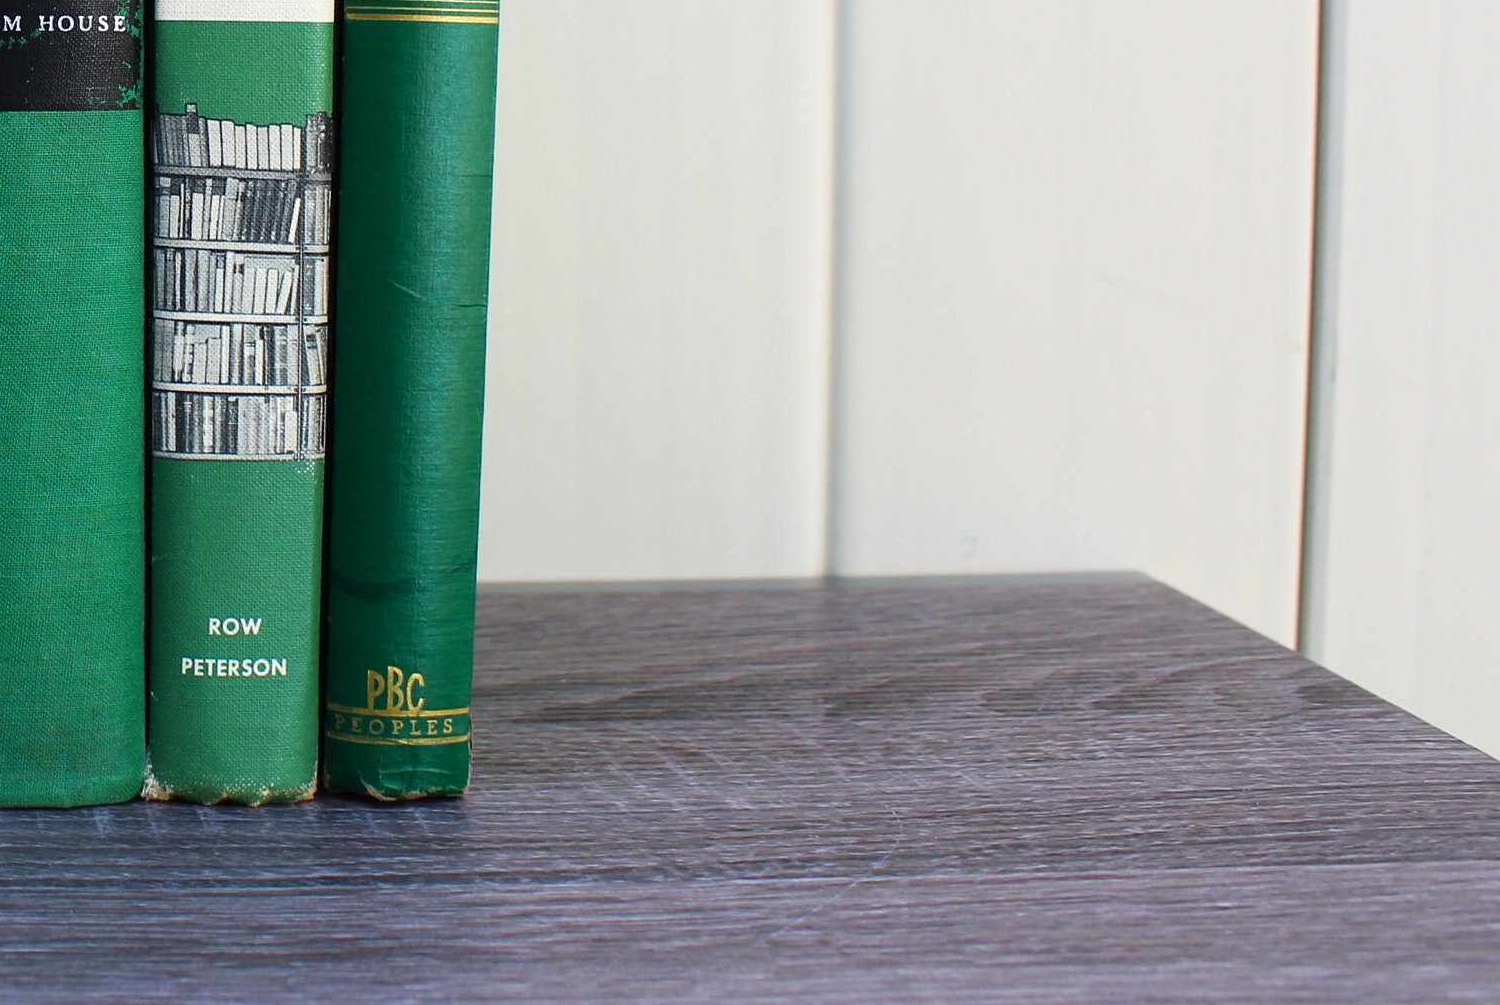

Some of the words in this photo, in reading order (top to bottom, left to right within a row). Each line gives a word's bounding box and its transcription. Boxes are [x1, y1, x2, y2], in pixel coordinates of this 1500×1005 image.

[38, 14, 127, 32] HOUSE
[208, 617, 262, 636] ROW
[181, 657, 288, 677] PETERSON
[368, 665, 426, 711] PBC
[335, 713, 454, 736] PEOPLES
